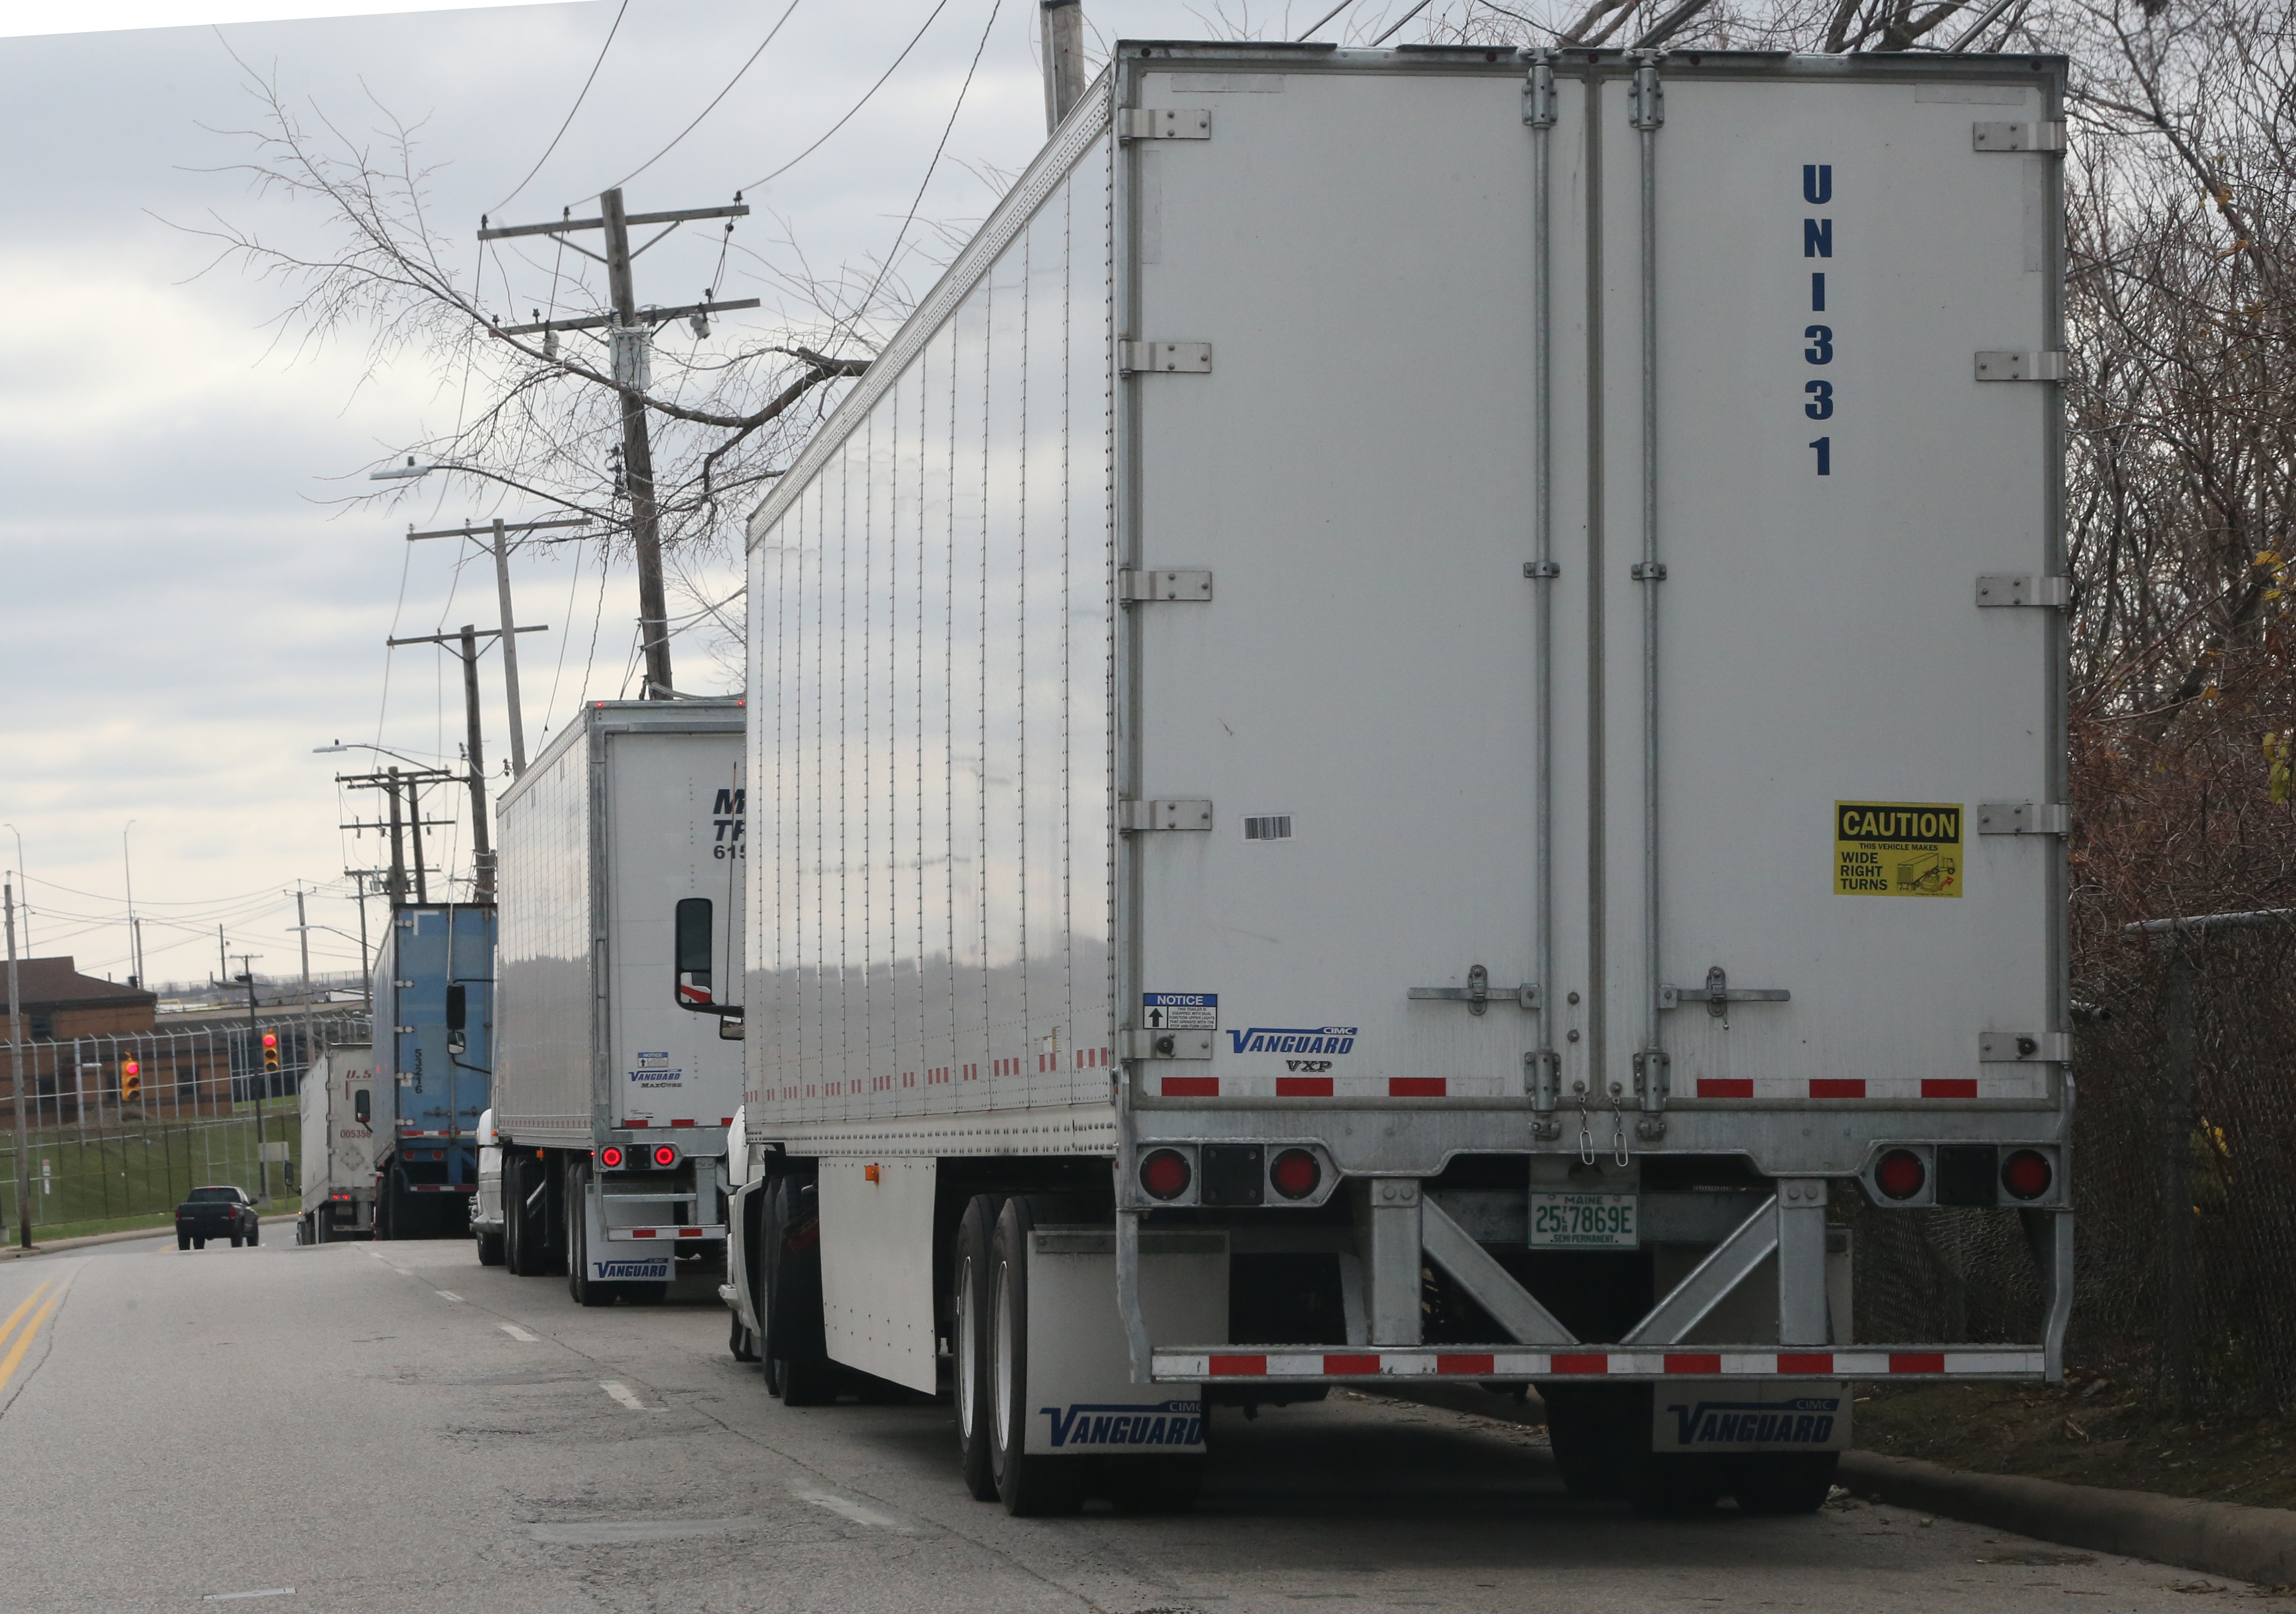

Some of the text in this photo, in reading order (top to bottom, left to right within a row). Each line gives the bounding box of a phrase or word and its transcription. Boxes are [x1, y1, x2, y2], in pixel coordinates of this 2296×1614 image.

[1803, 165, 1834, 475] UNI331
[1843, 811, 1955, 838] CAUTION
[1842, 852, 1878, 864] WIDE
[1840, 865, 1883, 877] RIGHT
[1840, 878, 1888, 890] TURNS
[1157, 995, 1203, 1005] NOTICE
[1226, 1028, 1354, 1054] VANGUARD
[1286, 1060, 1332, 1072] VXP
[628, 1071, 680, 1081] VANGUARD
[1565, 1196, 1603, 1205] MAINE
[1572, 1235, 1614, 1243] PERMANENT
[593, 1261, 667, 1278] VANGUARD
[1796, 1400, 1831, 1411] CIMC
[1039, 1404, 1203, 1447] VANGUARD
[1667, 1402, 1834, 1445] VANGUARD
